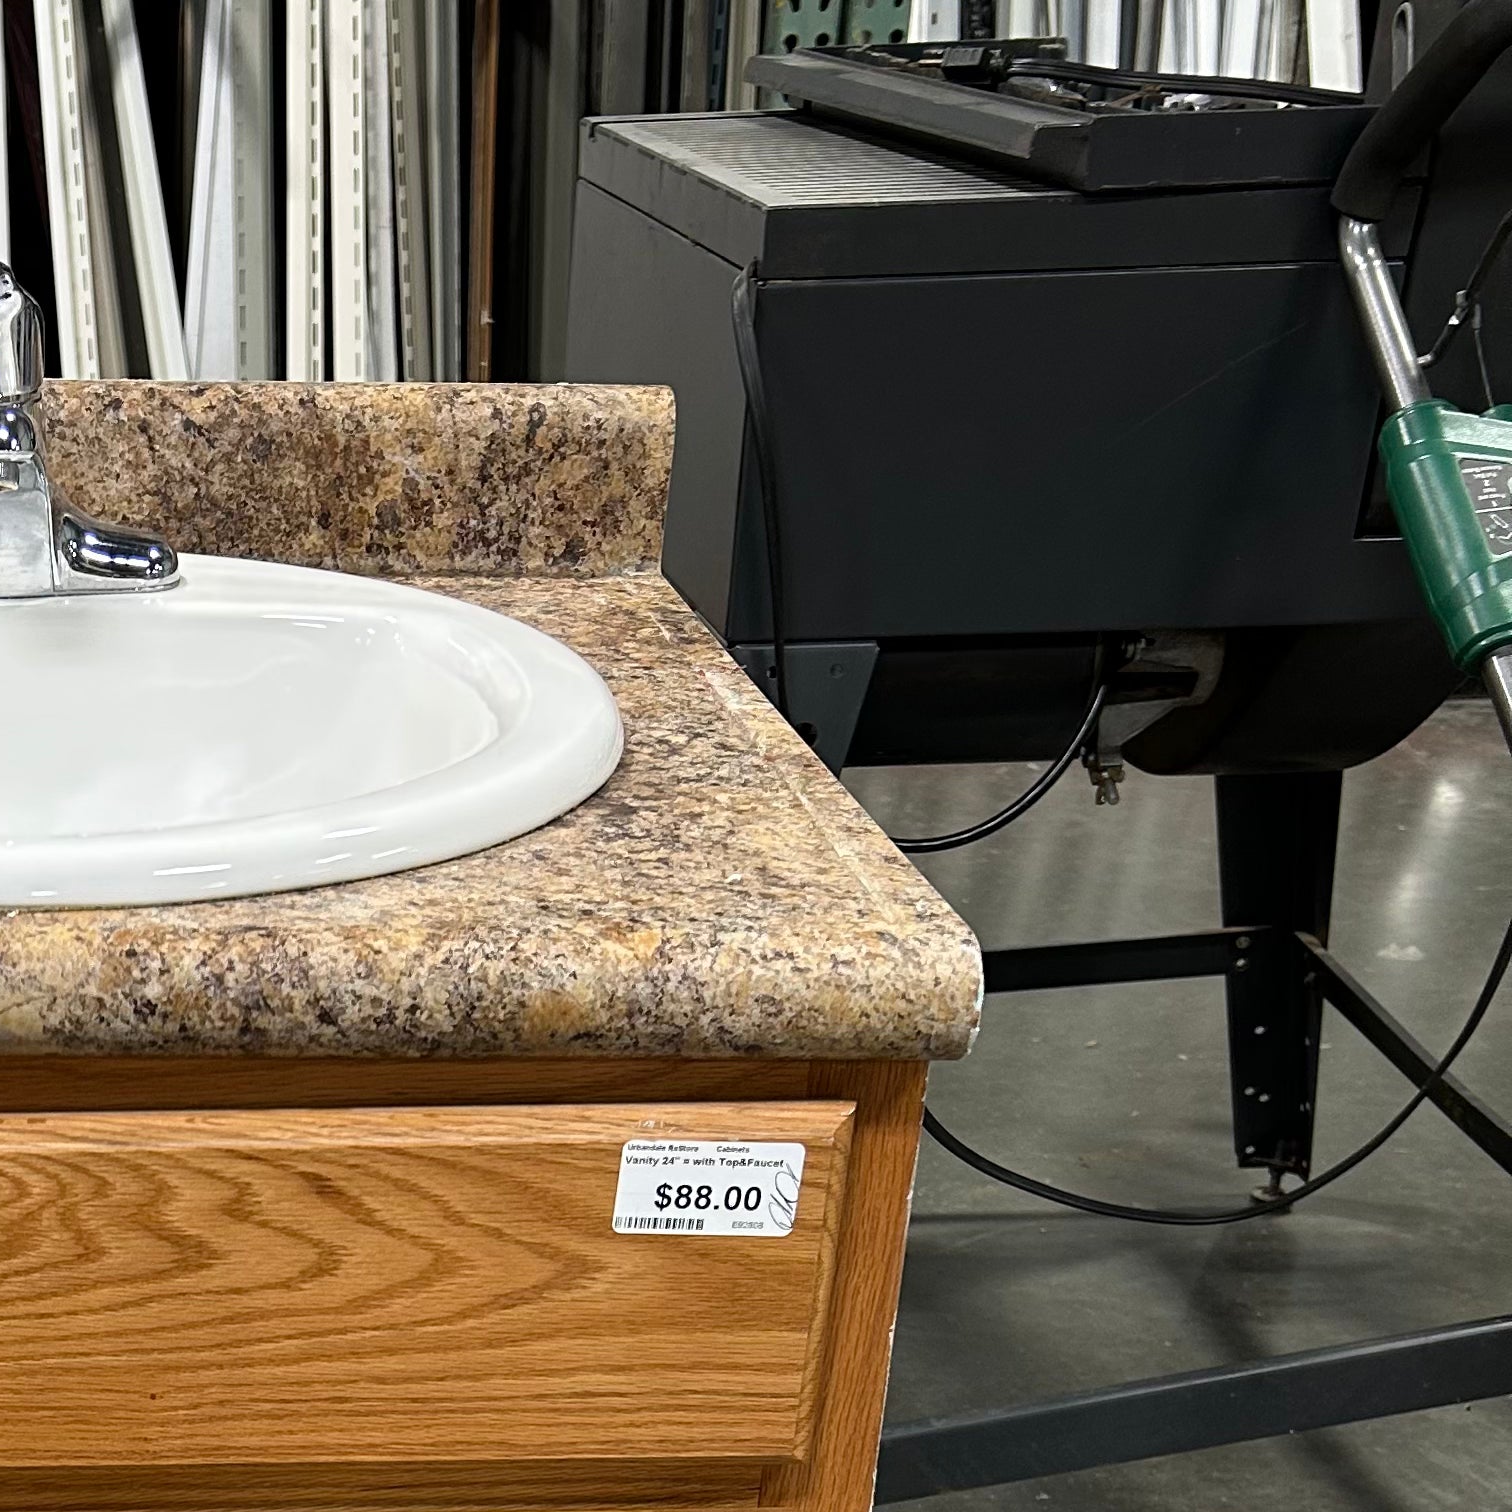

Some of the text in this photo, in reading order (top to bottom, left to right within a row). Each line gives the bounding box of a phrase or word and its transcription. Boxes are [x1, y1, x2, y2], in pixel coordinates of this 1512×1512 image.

[716, 1145, 750, 1153] Cabinets
[625, 1156, 659, 1167] Vanity
[692, 1157, 715, 1166] with
[719, 1157, 784, 1169] Top&Faucet
[654, 1182, 762, 1211] $88.00
